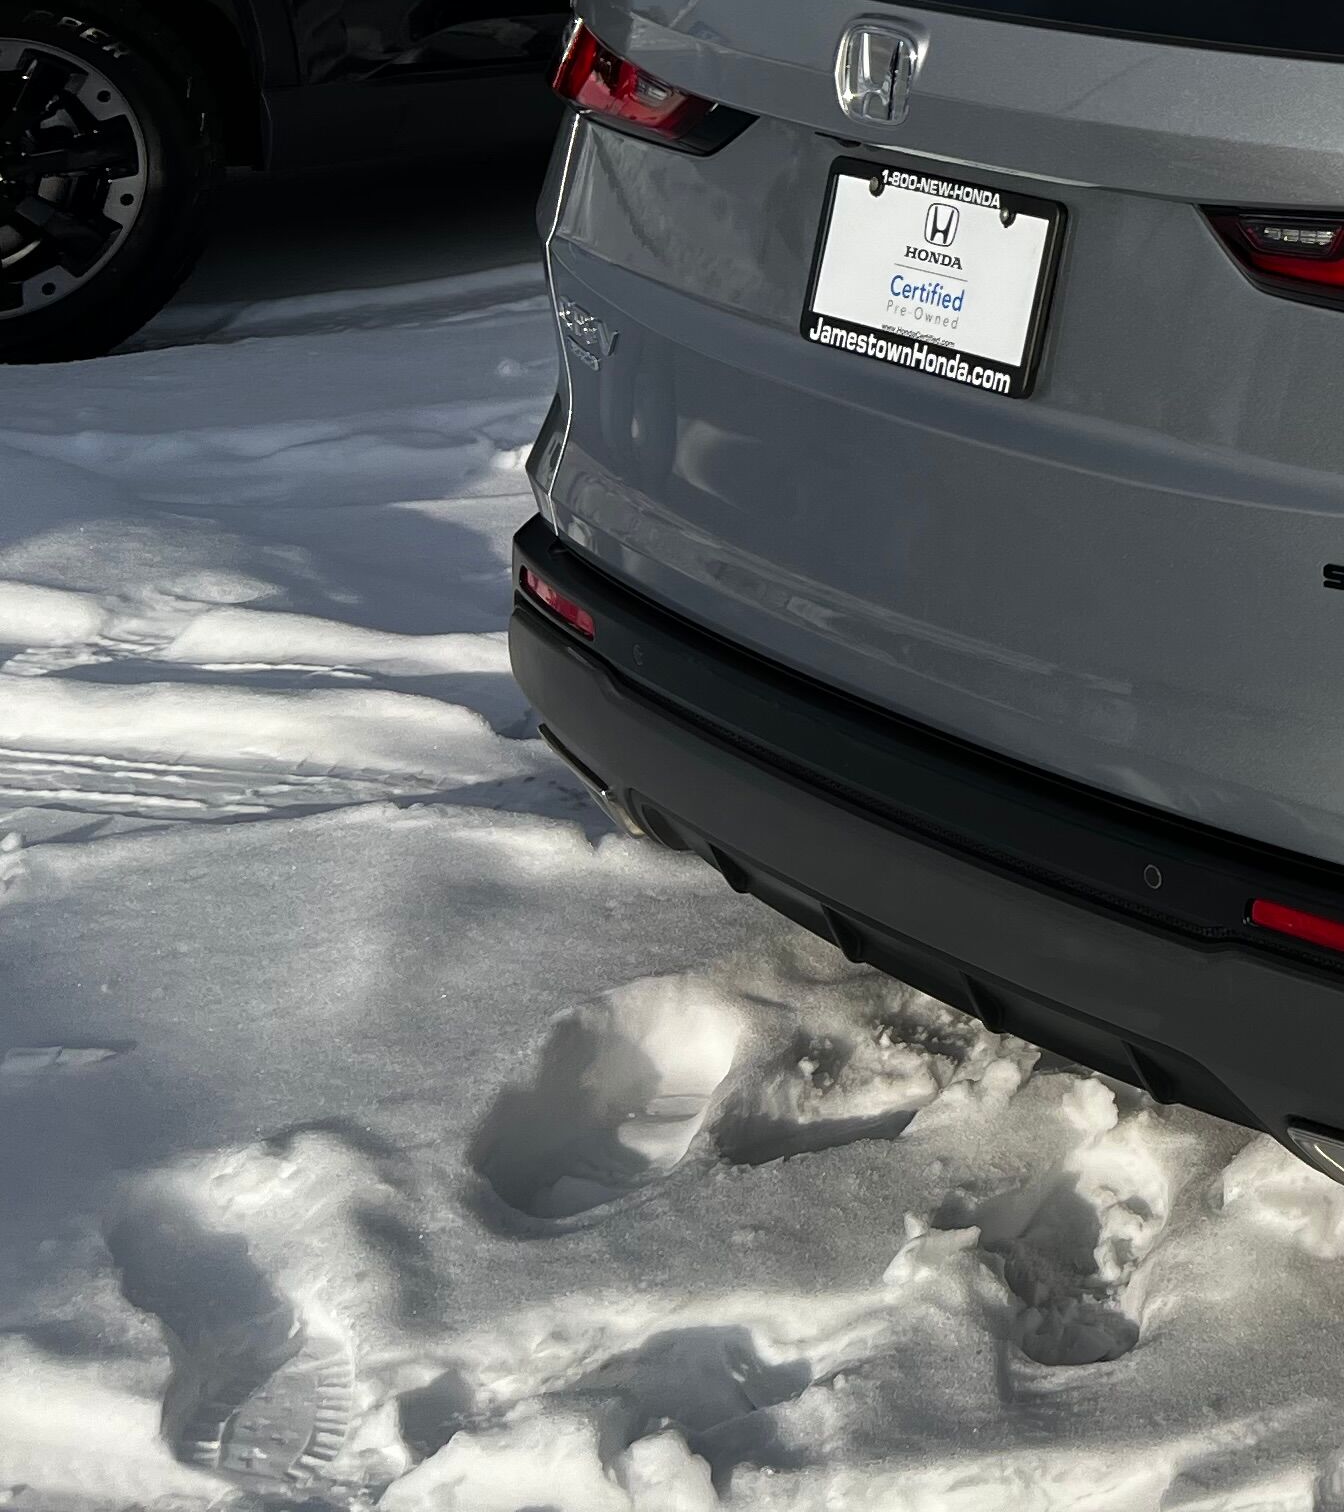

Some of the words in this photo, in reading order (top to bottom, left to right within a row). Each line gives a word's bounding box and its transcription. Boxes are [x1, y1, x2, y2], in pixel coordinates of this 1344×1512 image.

[881, 169, 1001, 209] 1-800-NEW-HONDA
[904, 245, 963, 270] HONDA
[890, 274, 965, 312] Certified
[886, 299, 961, 330] Pre-Owned
[809, 317, 1011, 393] JamestownHonda.com
